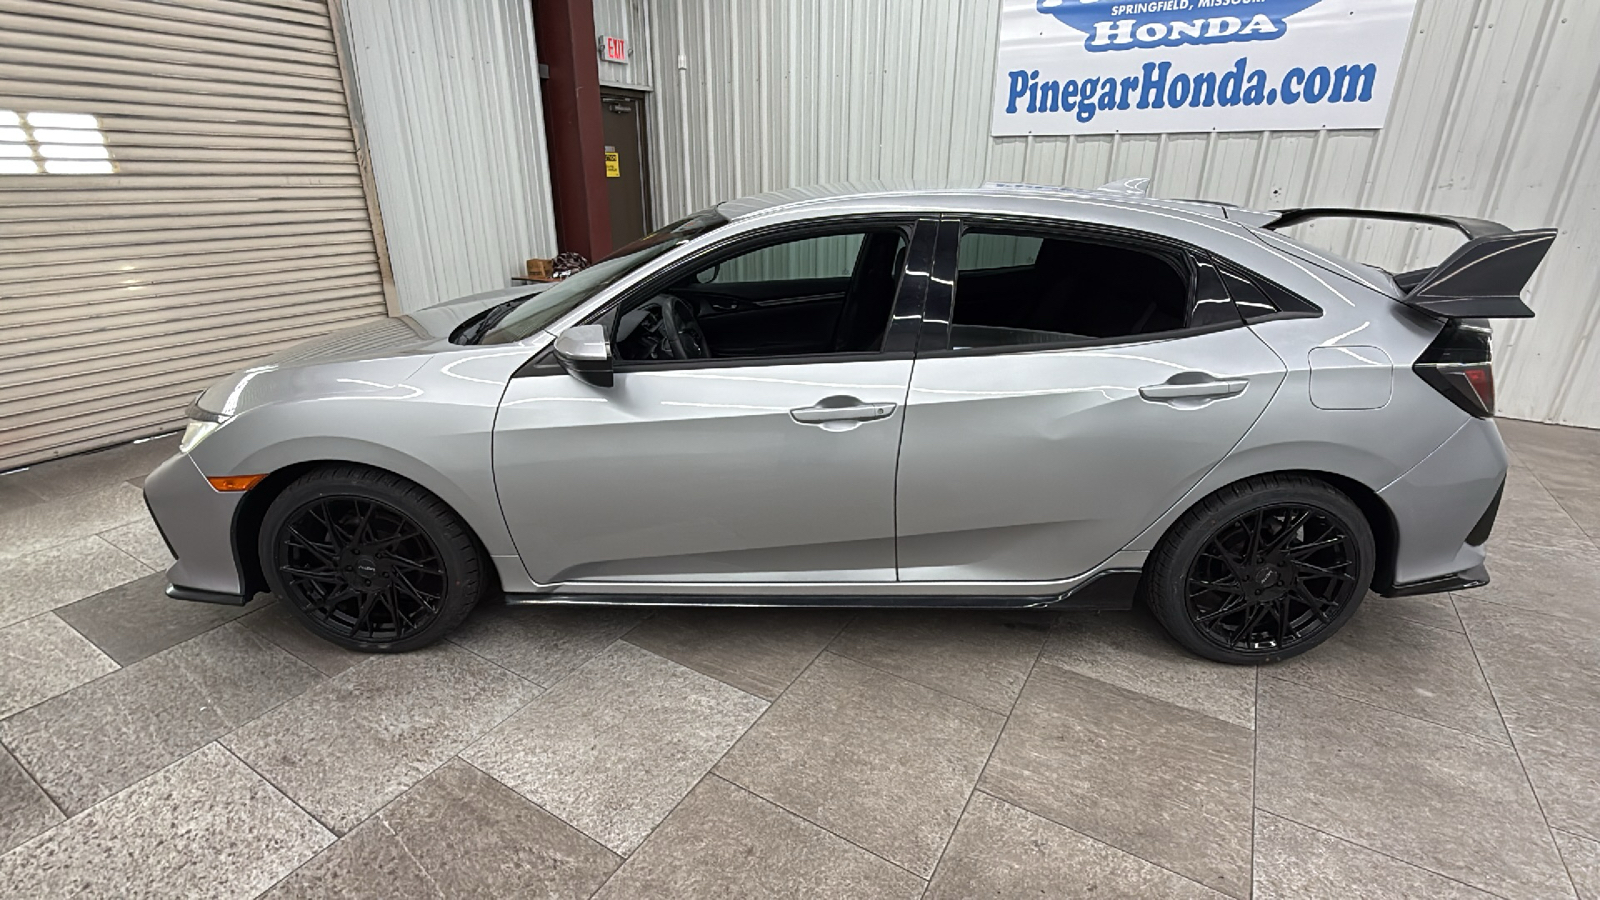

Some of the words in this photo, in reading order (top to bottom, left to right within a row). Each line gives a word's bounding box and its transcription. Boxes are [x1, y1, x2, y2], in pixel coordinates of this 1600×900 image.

[1111, 0, 1194, 16] SPRINGFIELD,
[1091, 14, 1279, 46] HONDA
[608, 37, 625, 60] EXIT
[1005, 58, 1377, 123] PinegarHonda.com
